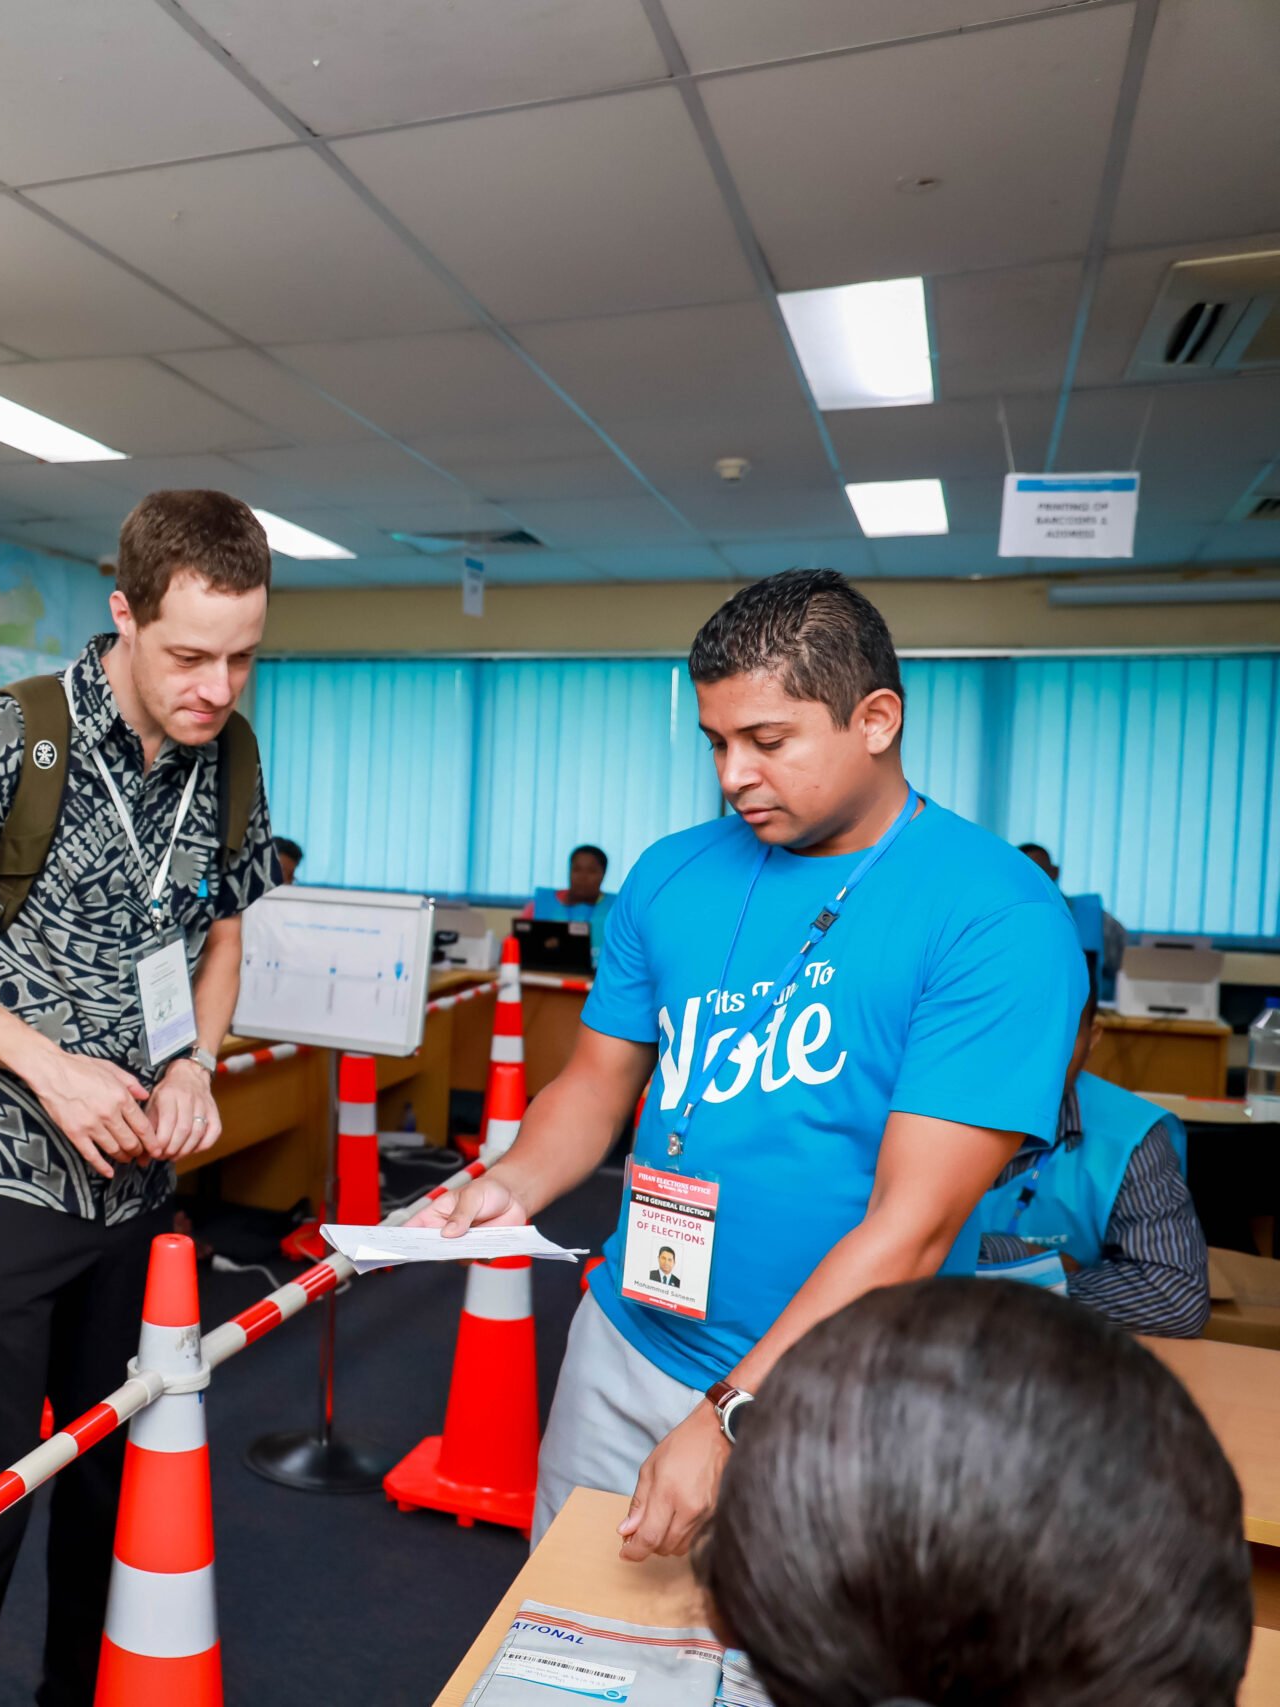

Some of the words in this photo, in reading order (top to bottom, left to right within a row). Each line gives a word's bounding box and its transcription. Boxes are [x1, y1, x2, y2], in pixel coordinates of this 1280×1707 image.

[706, 988, 745, 1015] Its
[805, 959, 836, 988] To
[658, 996, 848, 1111] Vote
[656, 1177, 689, 1190] ELECTIONS
[689, 1184, 711, 1195] OFFICE
[650, 1197, 678, 1210] GENERAL
[679, 1204, 710, 1218] ELECTION
[642, 1209, 702, 1231] SUPERVISOR
[636, 1220, 649, 1231] OF
[651, 1224, 705, 1246] ELECTIONS
[634, 1280, 670, 1296] Mohammed
